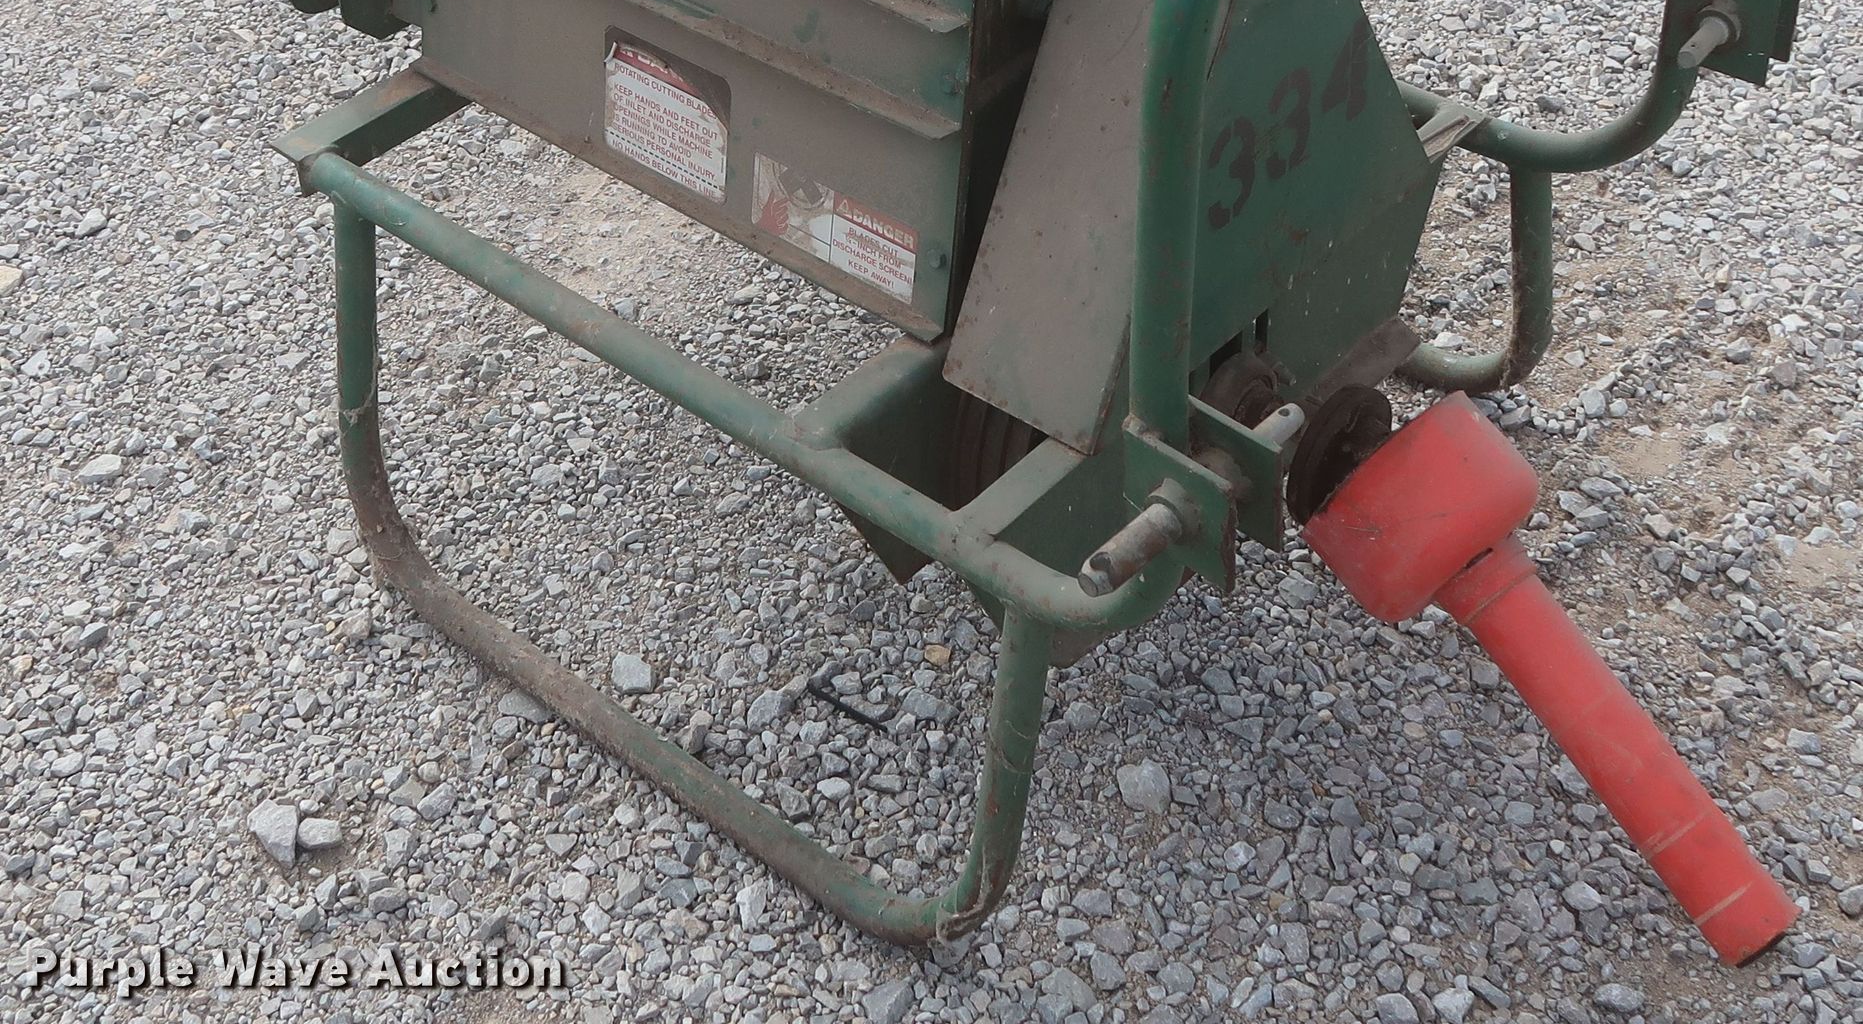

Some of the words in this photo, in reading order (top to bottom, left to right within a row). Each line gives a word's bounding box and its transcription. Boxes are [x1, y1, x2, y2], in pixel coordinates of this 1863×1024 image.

[614, 62, 650, 86] ROTATING
[651, 80, 685, 104] CUTTING
[613, 92, 624, 103] OF
[625, 97, 646, 116] INLET
[648, 110, 665, 124] AND
[666, 120, 711, 148] DISCHARGE
[613, 101, 651, 128] OPENINGS
[653, 122, 677, 141] WHILE
[678, 134, 713, 160] MACHINE
[614, 83, 633, 97] KEEP
[634, 92, 661, 112] HANDS
[662, 107, 679, 121] AND
[680, 116, 700, 131] FEET
[701, 127, 718, 141] OUT
[612, 121, 645, 145] SERIOUS
[646, 139, 686, 166] PERSONAL
[688, 161, 717, 182] INJURY.
[621, 117, 656, 141] RUNNING
[657, 135, 668, 147] TO
[668, 142, 692, 159] AVOID
[612, 140, 624, 151] NO
[624, 146, 651, 166] HANDS
[651, 160, 678, 179] BELOW
[680, 173, 698, 190] THIS
[852, 206, 914, 249] DANGER
[832, 239, 877, 267] DISCHARGE
[878, 251, 902, 269] FROM
[881, 244, 898, 257] CUT
[848, 259, 869, 274] KEEP
[870, 271, 894, 289] AWAY!
